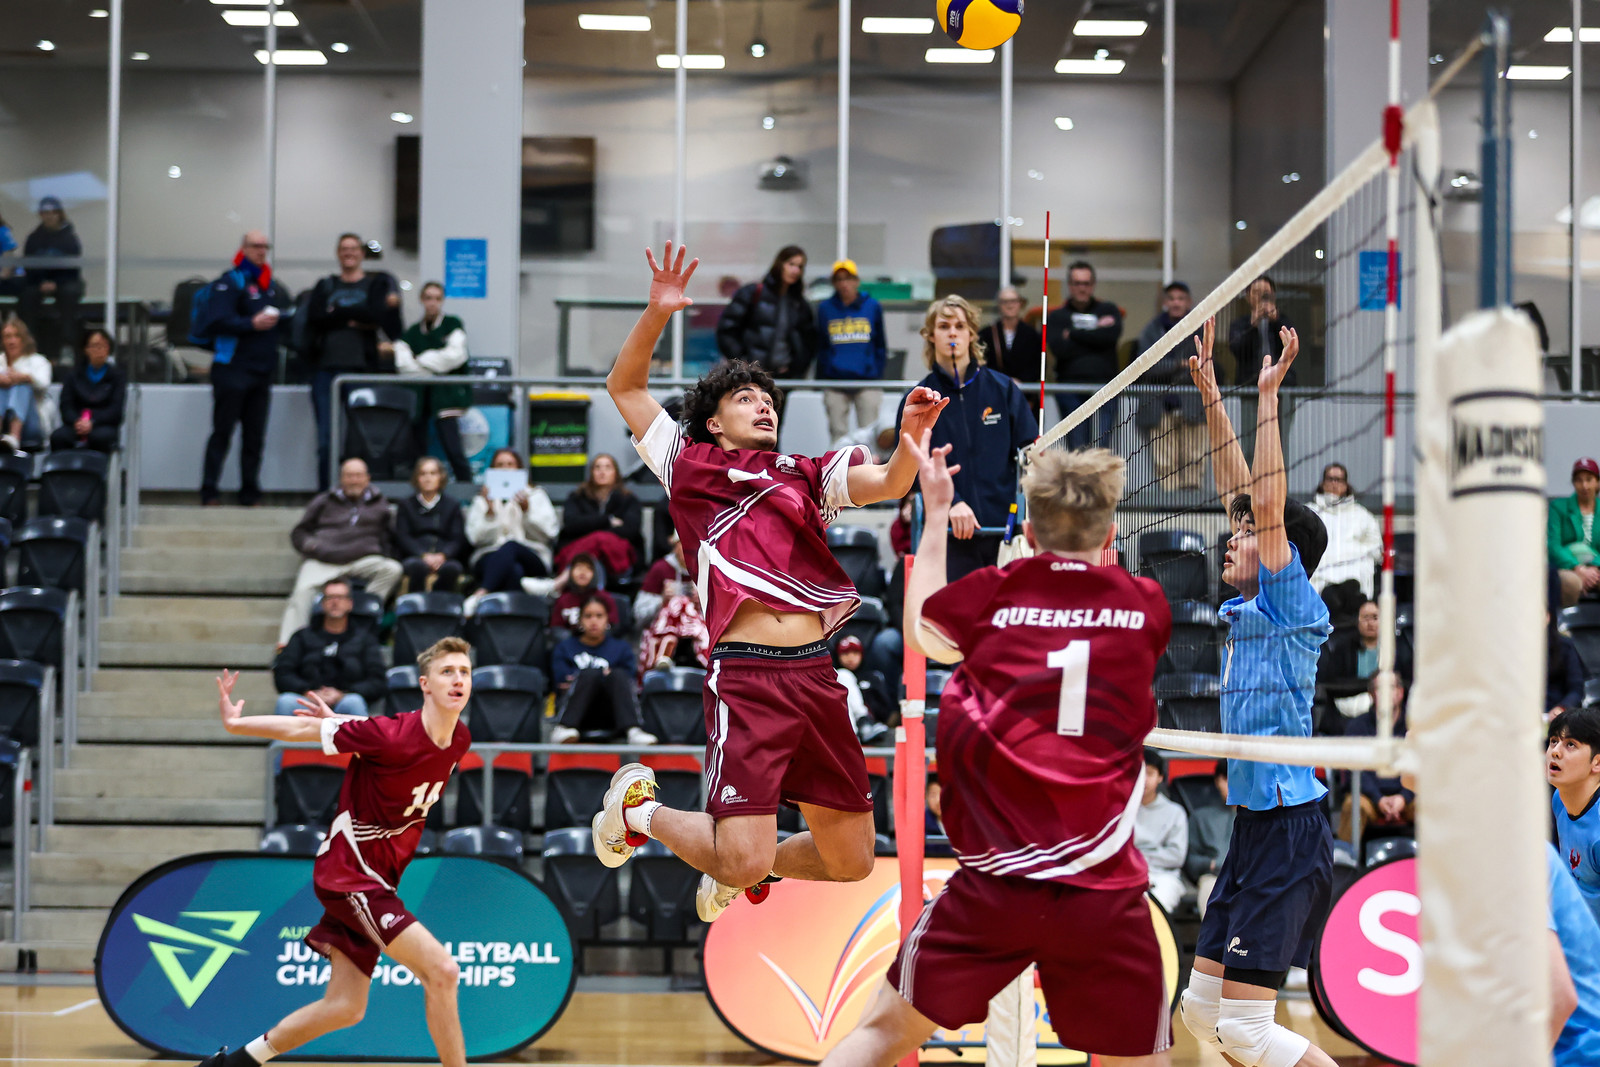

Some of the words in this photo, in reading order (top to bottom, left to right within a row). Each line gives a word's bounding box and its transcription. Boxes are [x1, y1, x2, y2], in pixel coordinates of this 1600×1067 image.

[991, 606, 1146, 630] QUEENSLAND
[1046, 639, 1091, 737] 1
[403, 781, 444, 818] 14
[443, 941, 561, 964] LEYBALL
